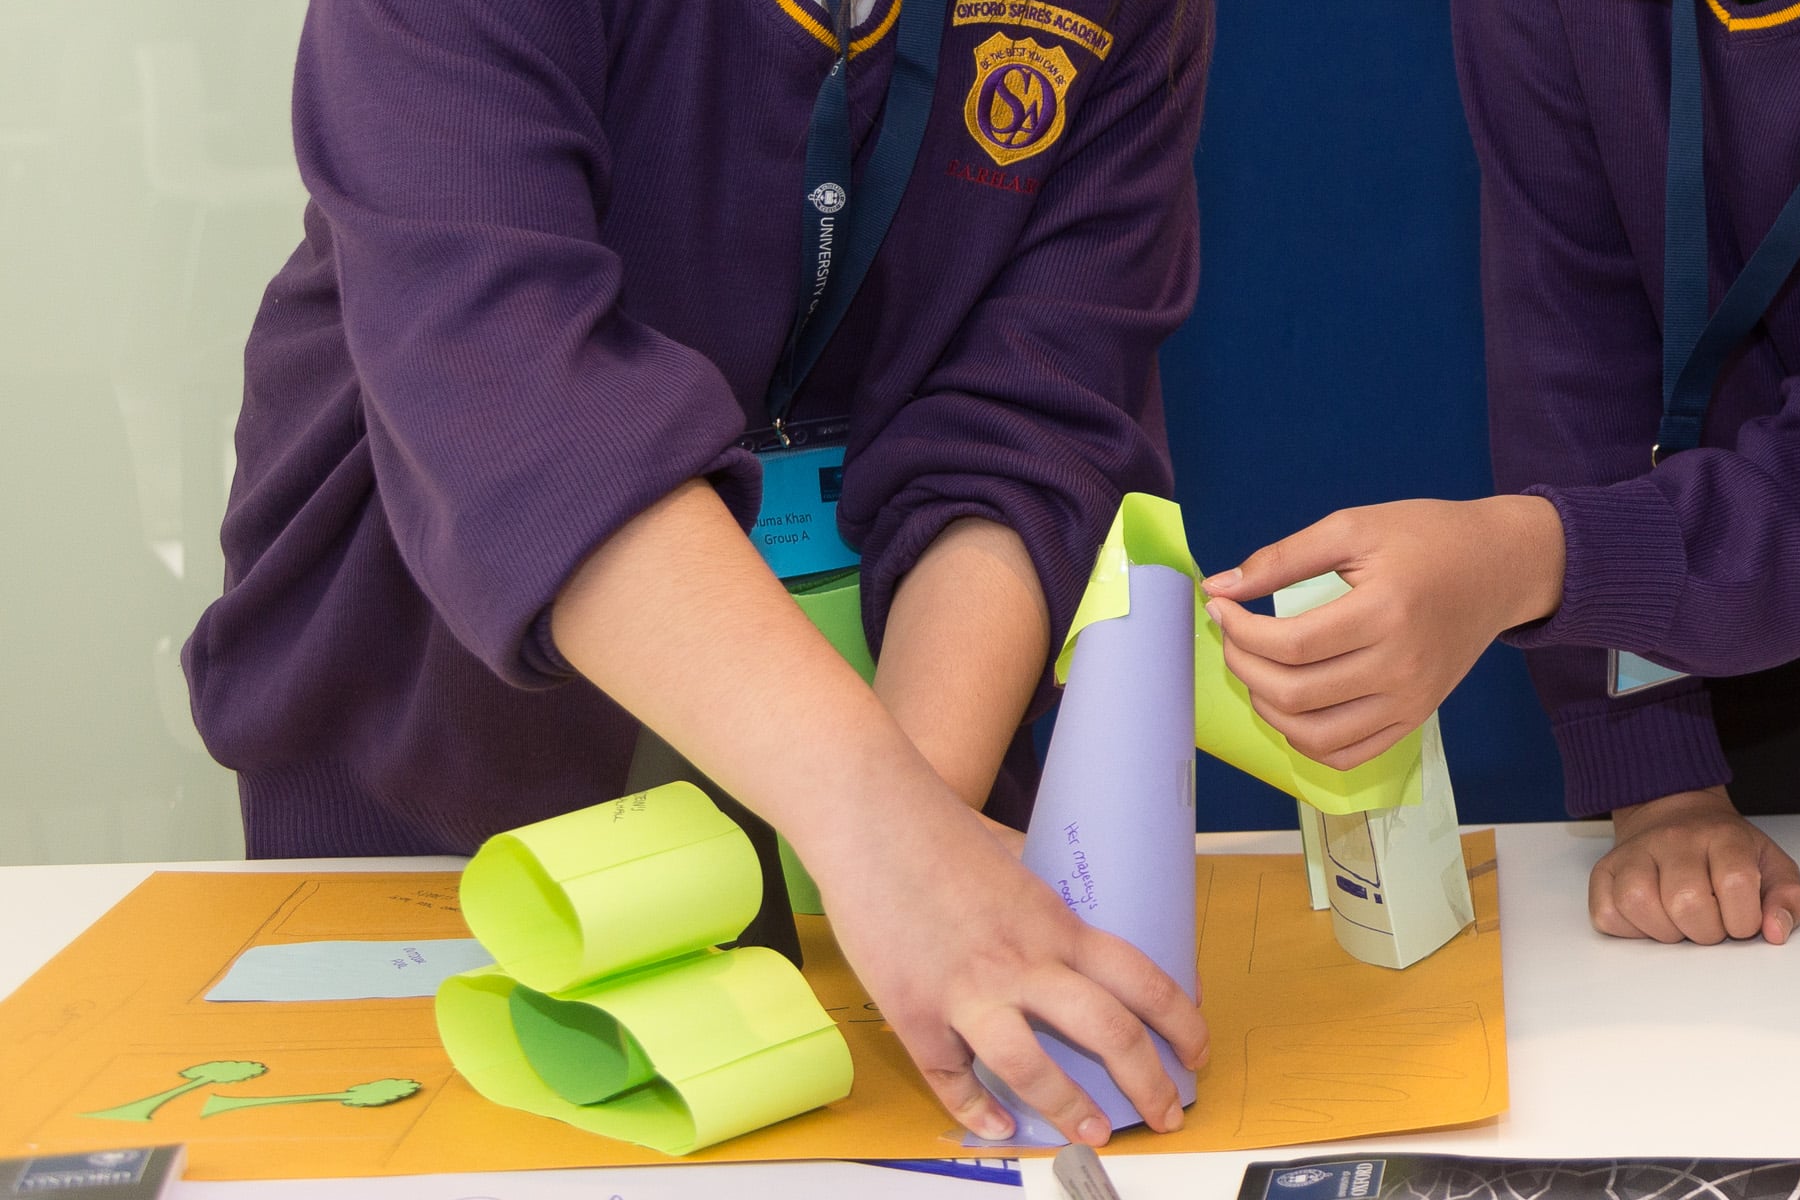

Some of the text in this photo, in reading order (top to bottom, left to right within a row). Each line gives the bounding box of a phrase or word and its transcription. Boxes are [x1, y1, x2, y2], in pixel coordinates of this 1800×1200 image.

[957, 1, 1109, 51] OXFORD SPIRES ACADEMY
[813, 217, 834, 296] UNIVERSITY
[764, 532, 810, 545] Group A
[786, 512, 812, 524] Khan
[1064, 821, 1099, 909] Her majesty's
[1351, 1162, 1374, 1197] OXFORD
